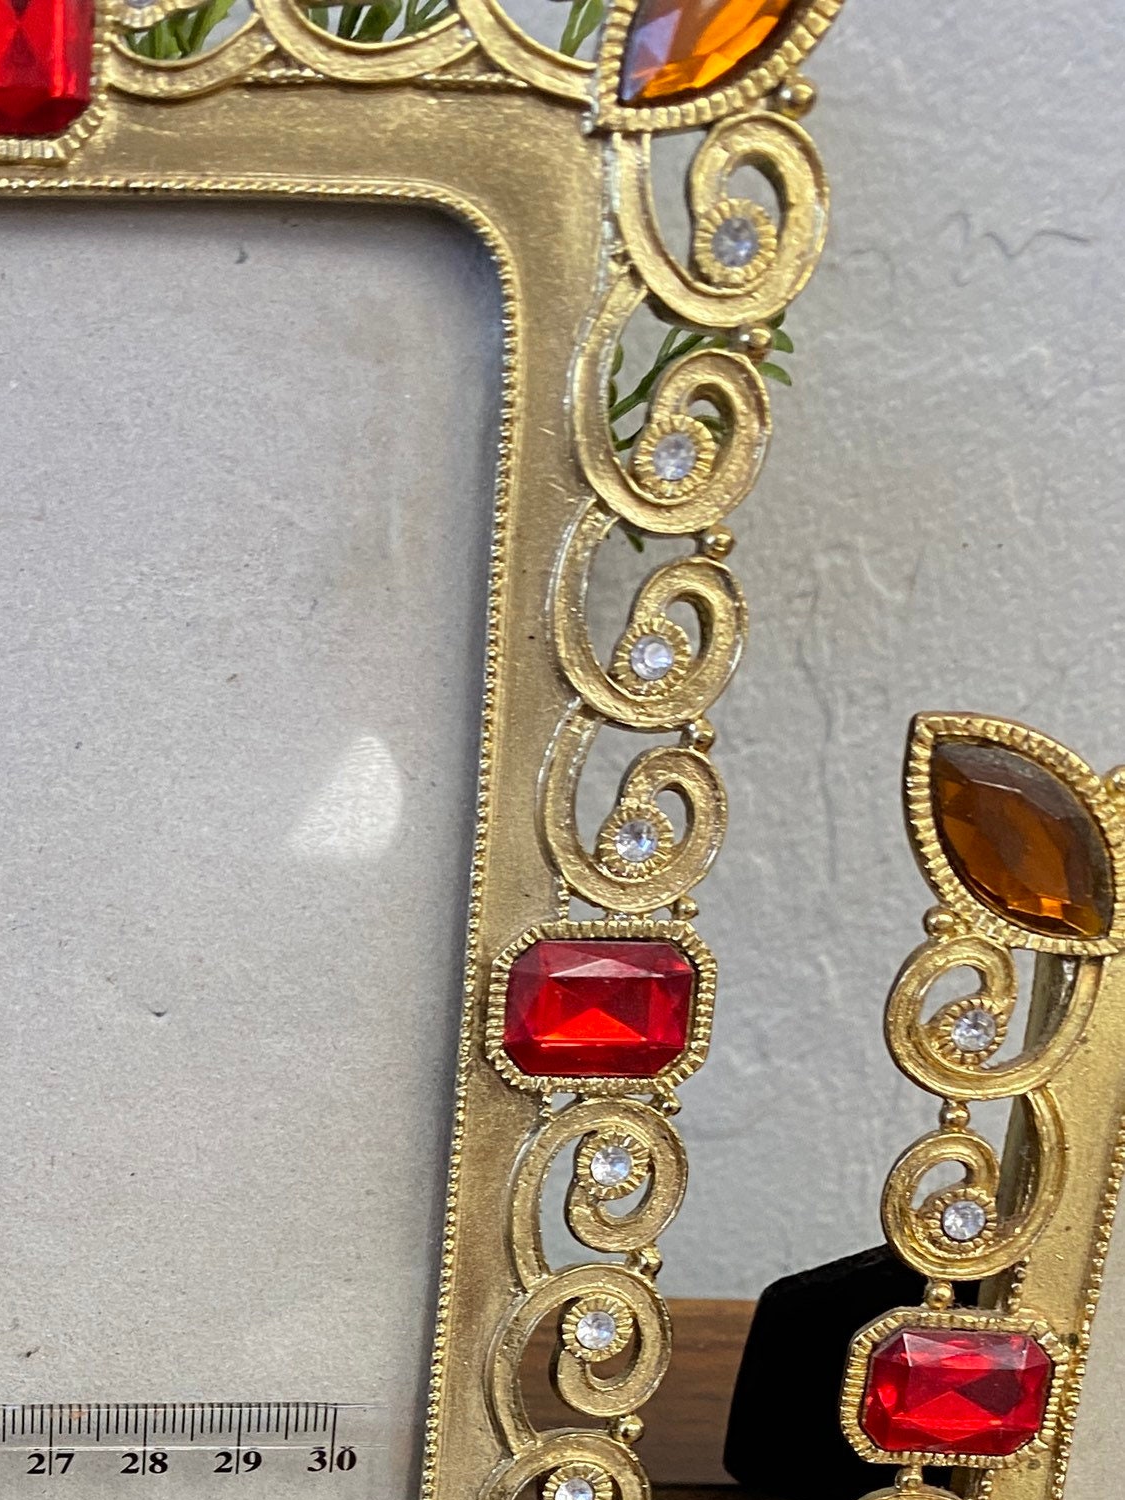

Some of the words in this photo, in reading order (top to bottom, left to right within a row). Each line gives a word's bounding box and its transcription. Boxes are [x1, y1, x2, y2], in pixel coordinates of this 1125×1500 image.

[27, 1453, 75, 1474] 27
[121, 1452, 169, 1474] 28
[214, 1451, 262, 1473] 29
[307, 1448, 357, 1473] 30
